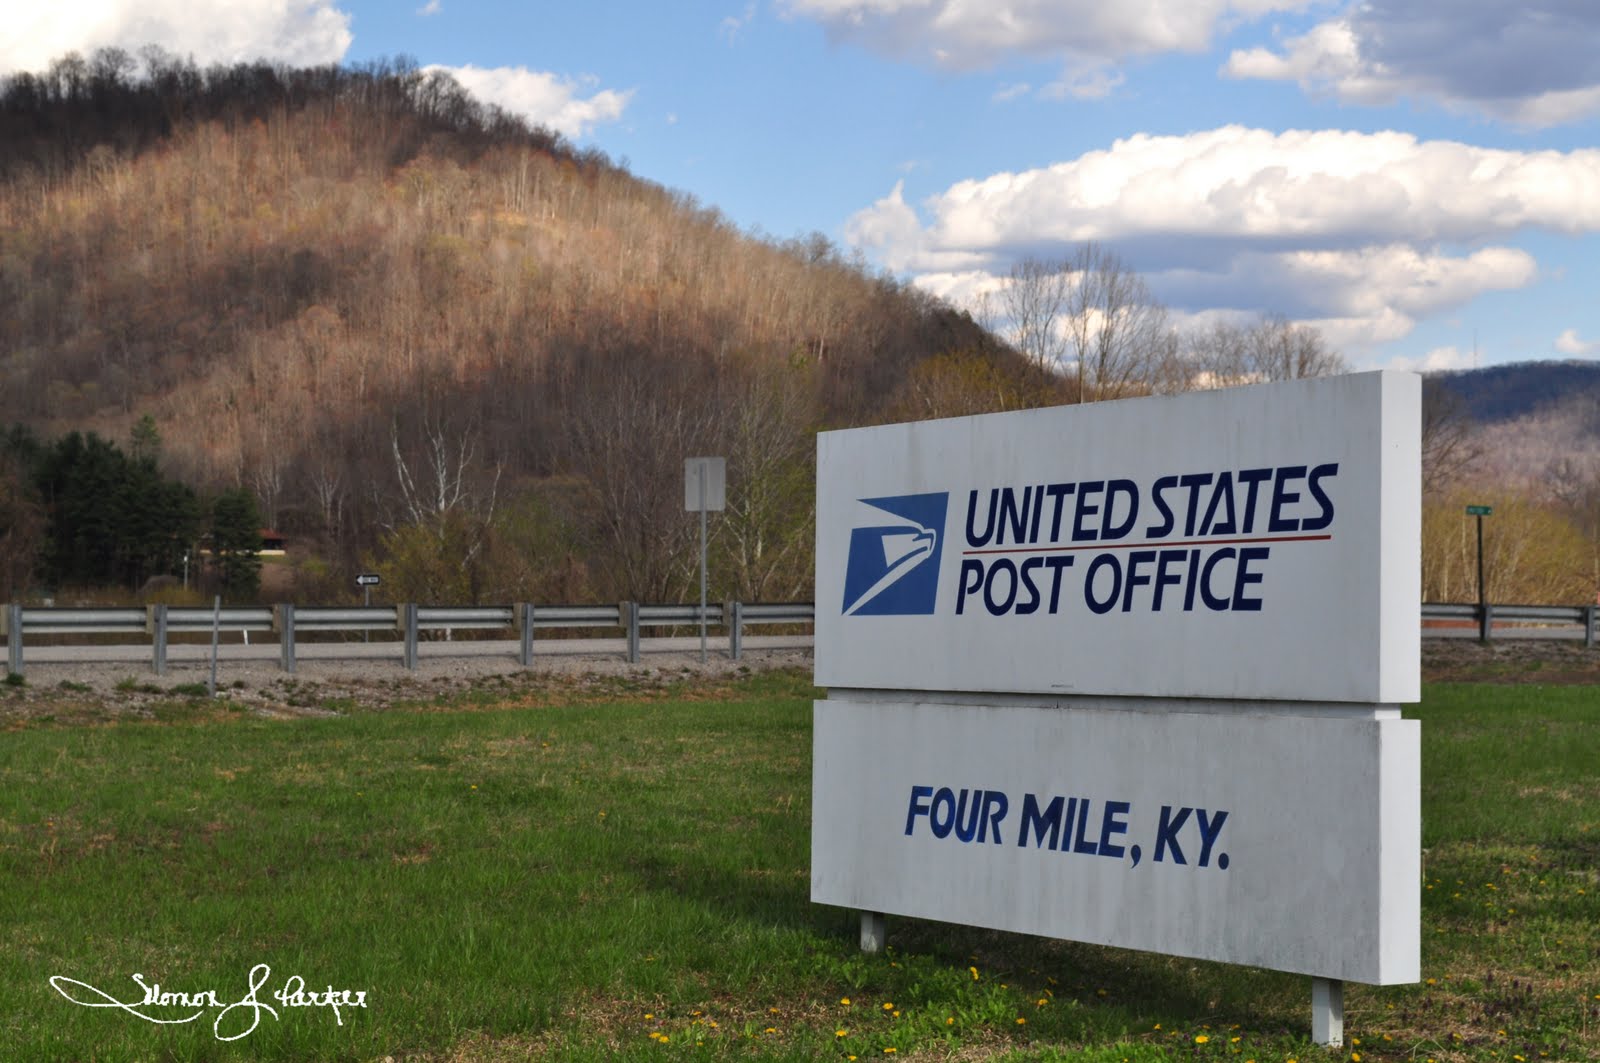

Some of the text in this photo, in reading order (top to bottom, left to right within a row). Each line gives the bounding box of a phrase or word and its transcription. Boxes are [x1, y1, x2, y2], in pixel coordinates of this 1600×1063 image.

[965, 462, 1340, 548] UNITED STATES
[955, 546, 1271, 617] POST OFFICE
[904, 785, 1230, 871] FOUR MILE, KY.
